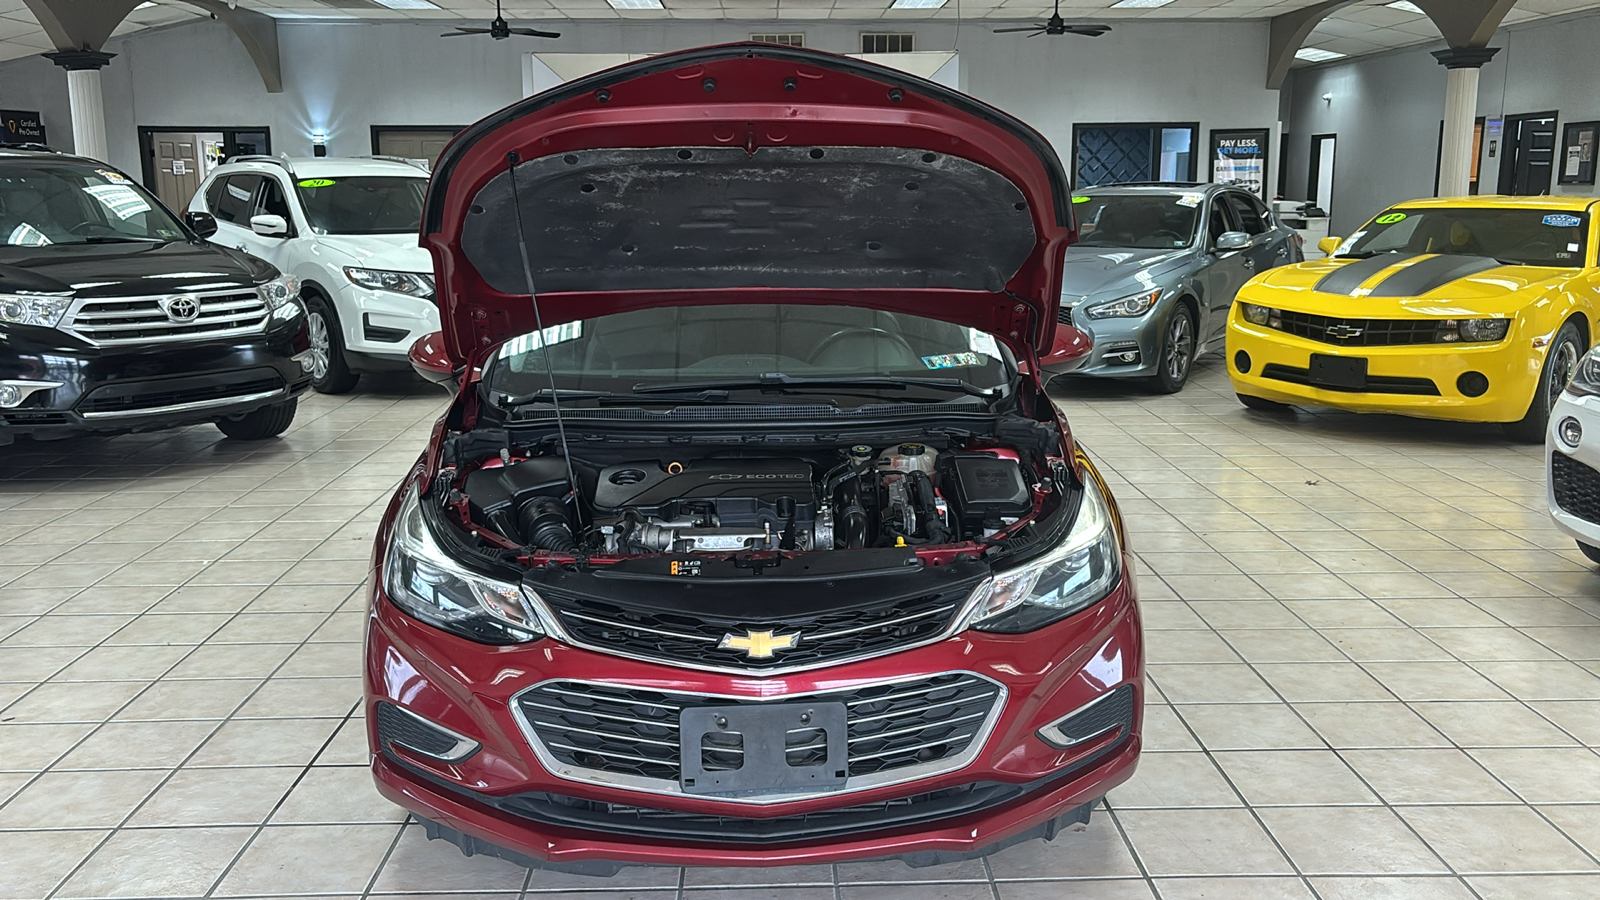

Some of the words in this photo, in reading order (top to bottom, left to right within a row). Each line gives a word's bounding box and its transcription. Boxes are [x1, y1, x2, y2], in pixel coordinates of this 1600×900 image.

[20, 119, 37, 128] Certified
[1220, 139, 1236, 147] PAY
[1237, 139, 1259, 147] LESS.
[1234, 146, 1262, 154] MORE.
